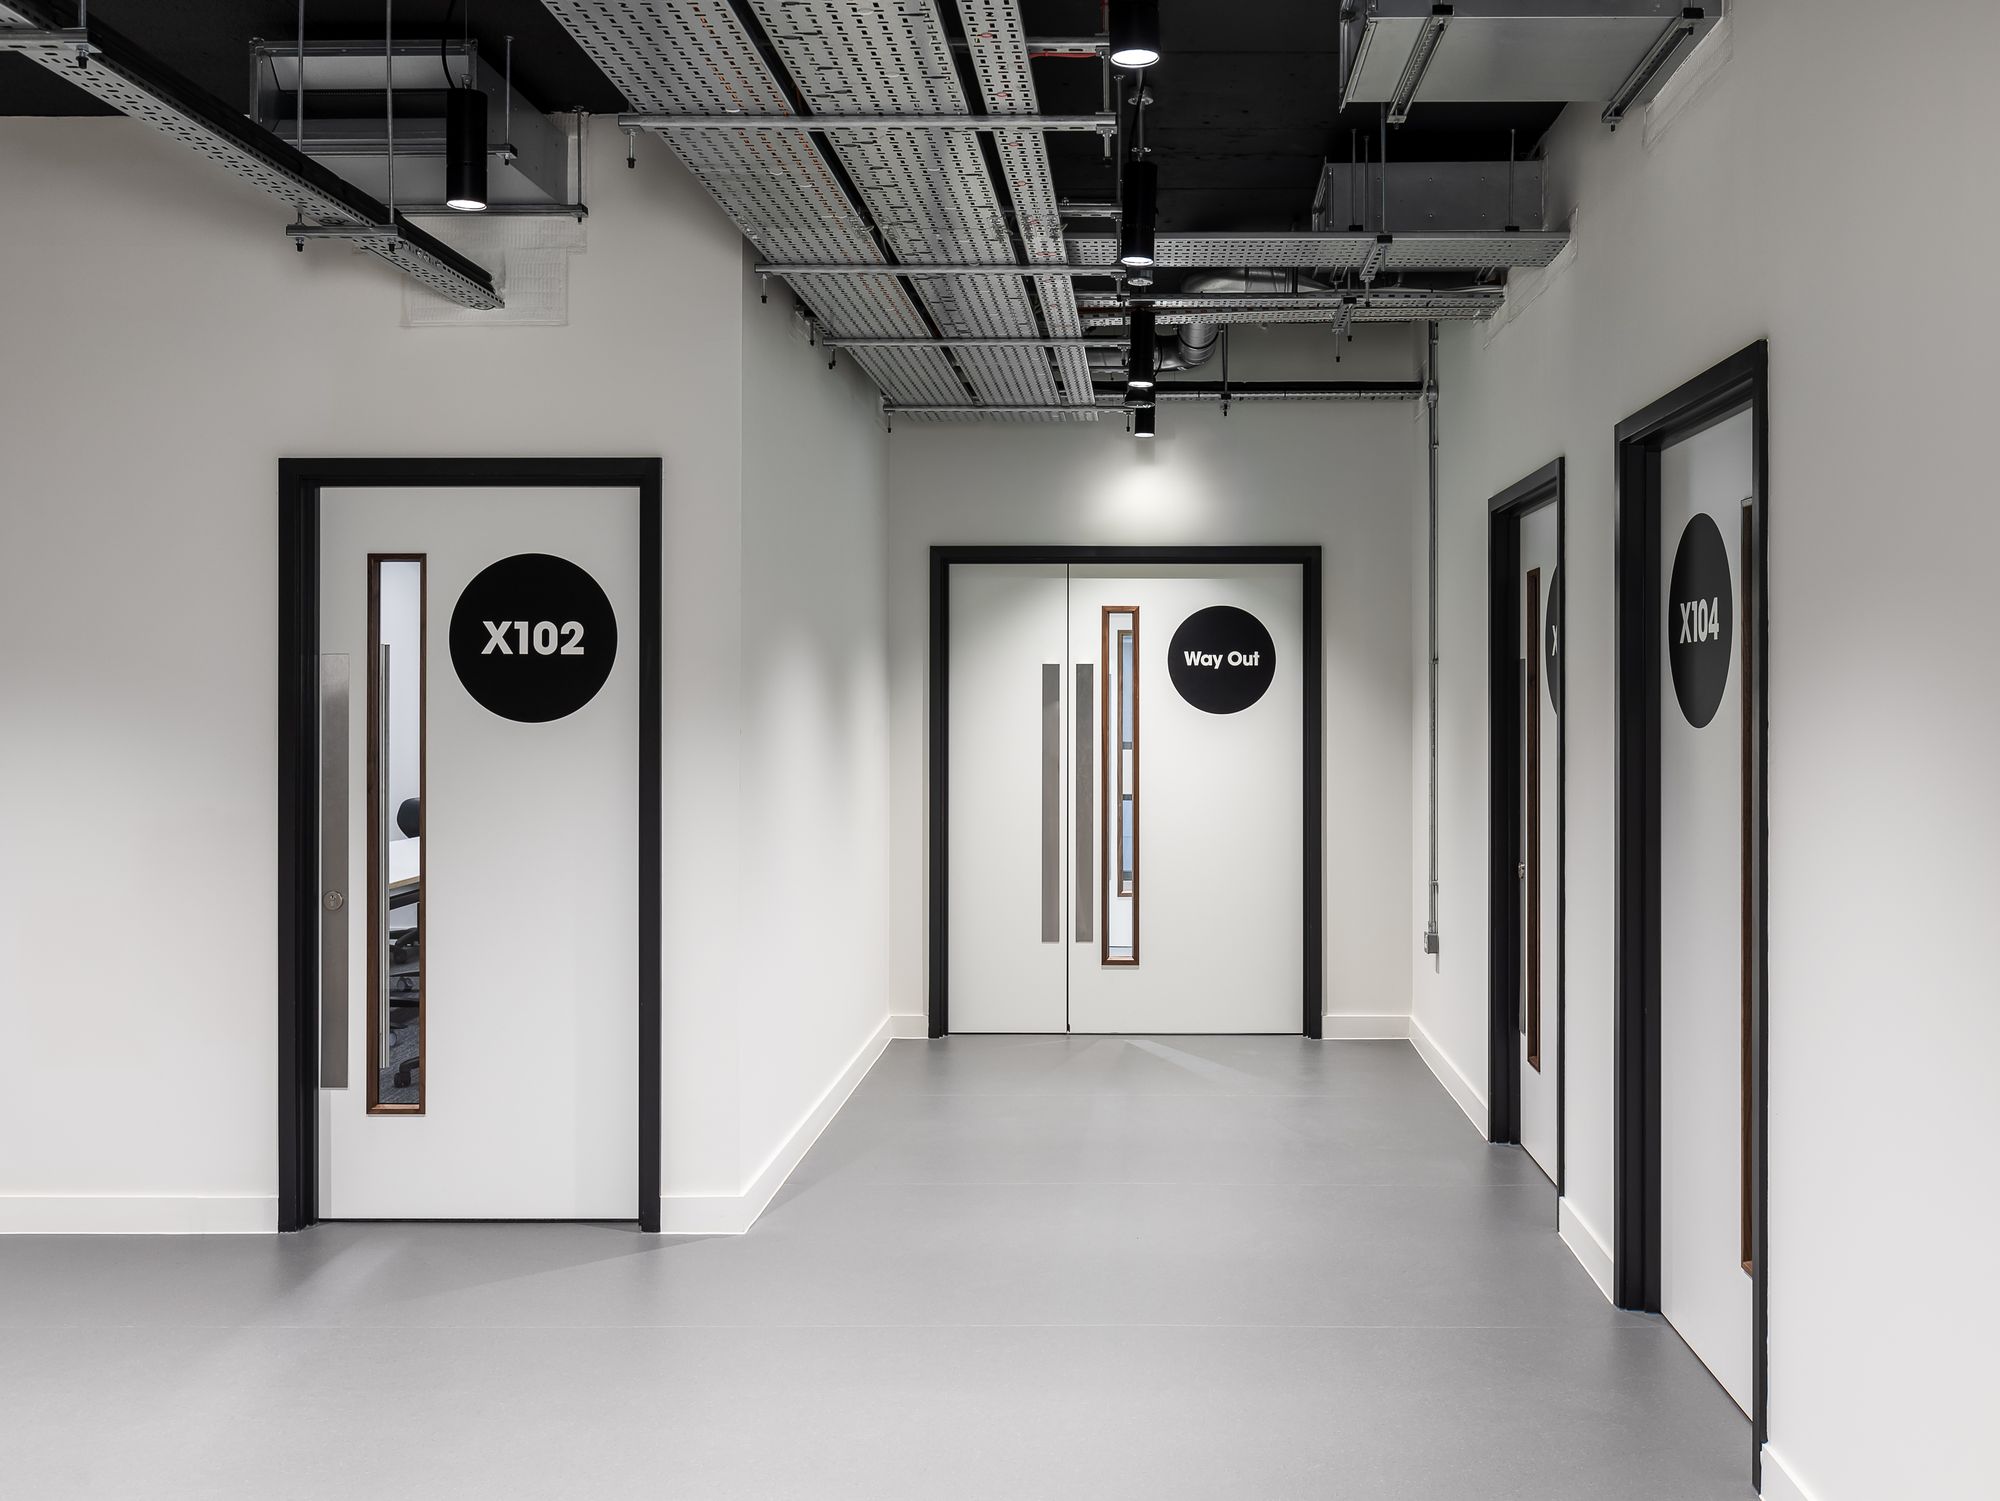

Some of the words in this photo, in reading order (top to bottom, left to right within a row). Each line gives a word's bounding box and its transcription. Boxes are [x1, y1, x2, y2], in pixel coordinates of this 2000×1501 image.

[481, 620, 585, 656] X102
[1680, 597, 1720, 644] X104
[1183, 650, 1223, 670] Way
[1227, 650, 1260, 667] Out
